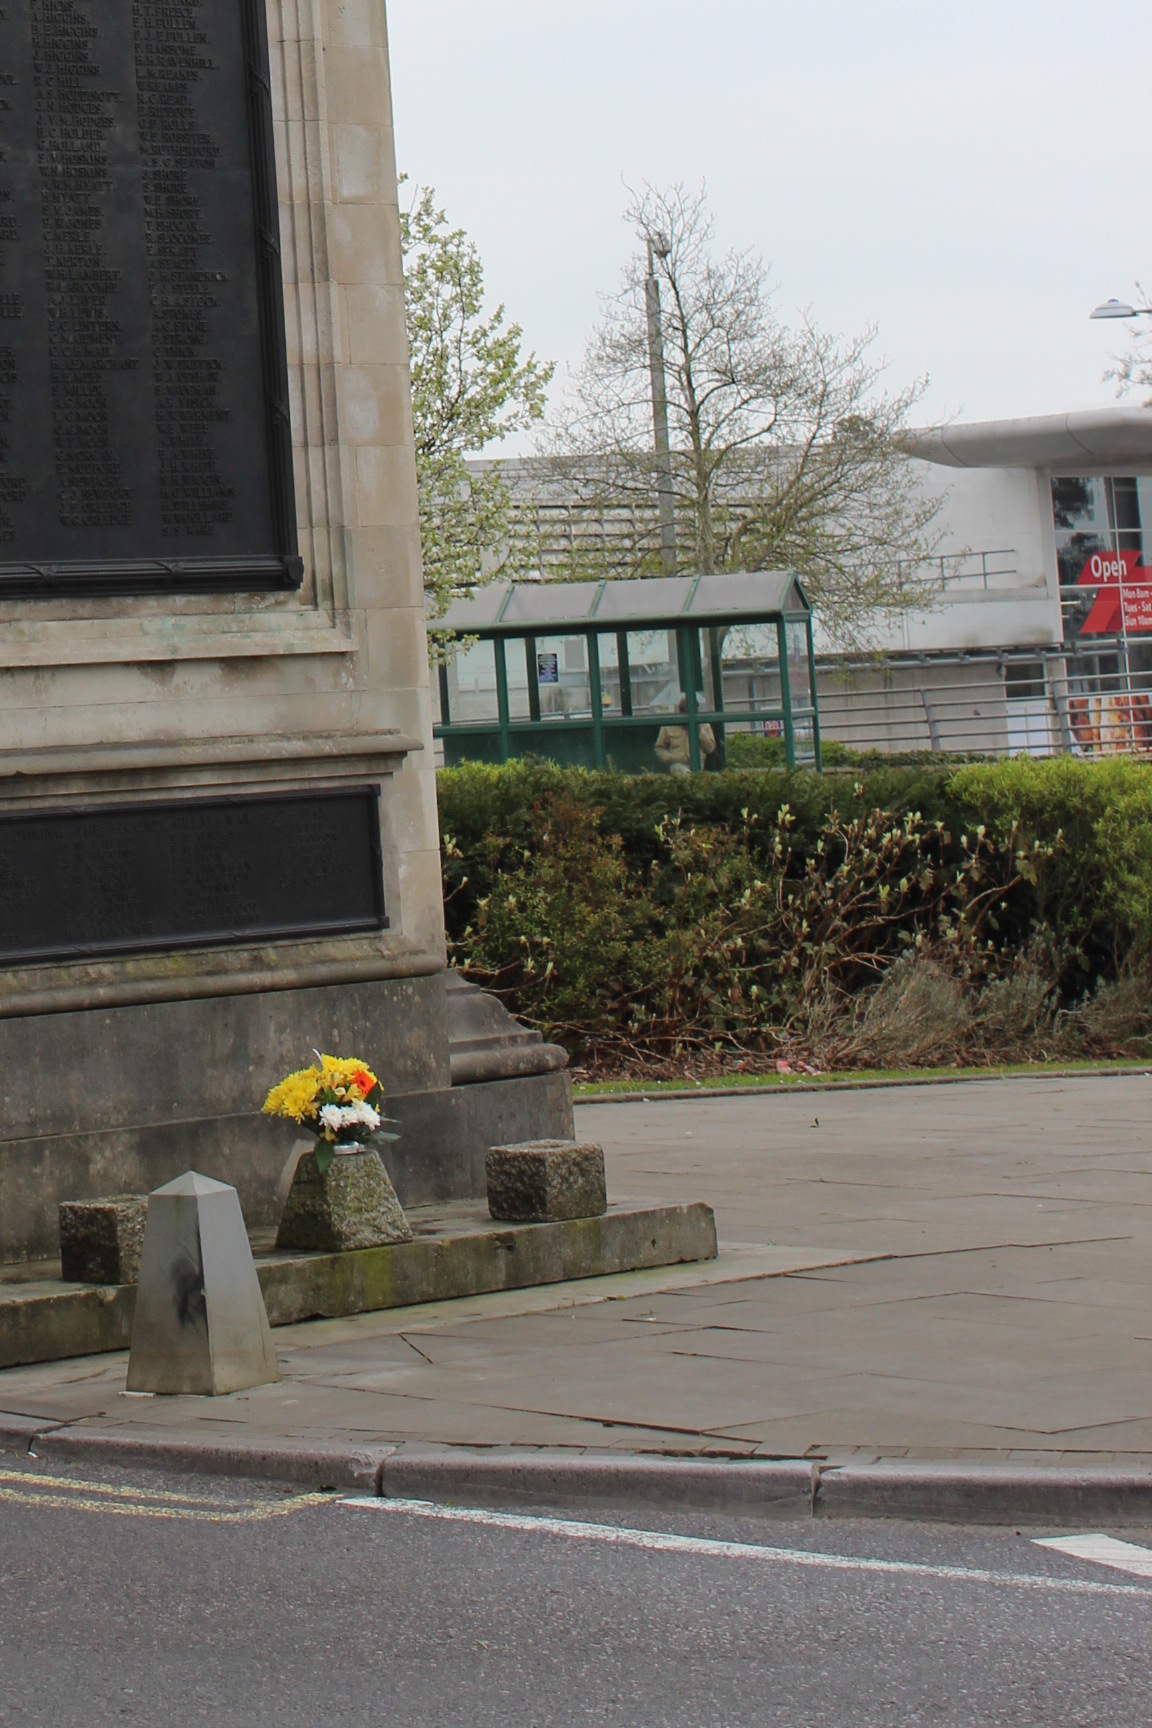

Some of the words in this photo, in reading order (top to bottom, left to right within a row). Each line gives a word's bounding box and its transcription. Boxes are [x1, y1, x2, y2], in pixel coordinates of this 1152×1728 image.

[1091, 555, 1127, 582] Open
[1123, 588, 1136, 599] Mon
[1125, 615, 1137, 626] Sun
